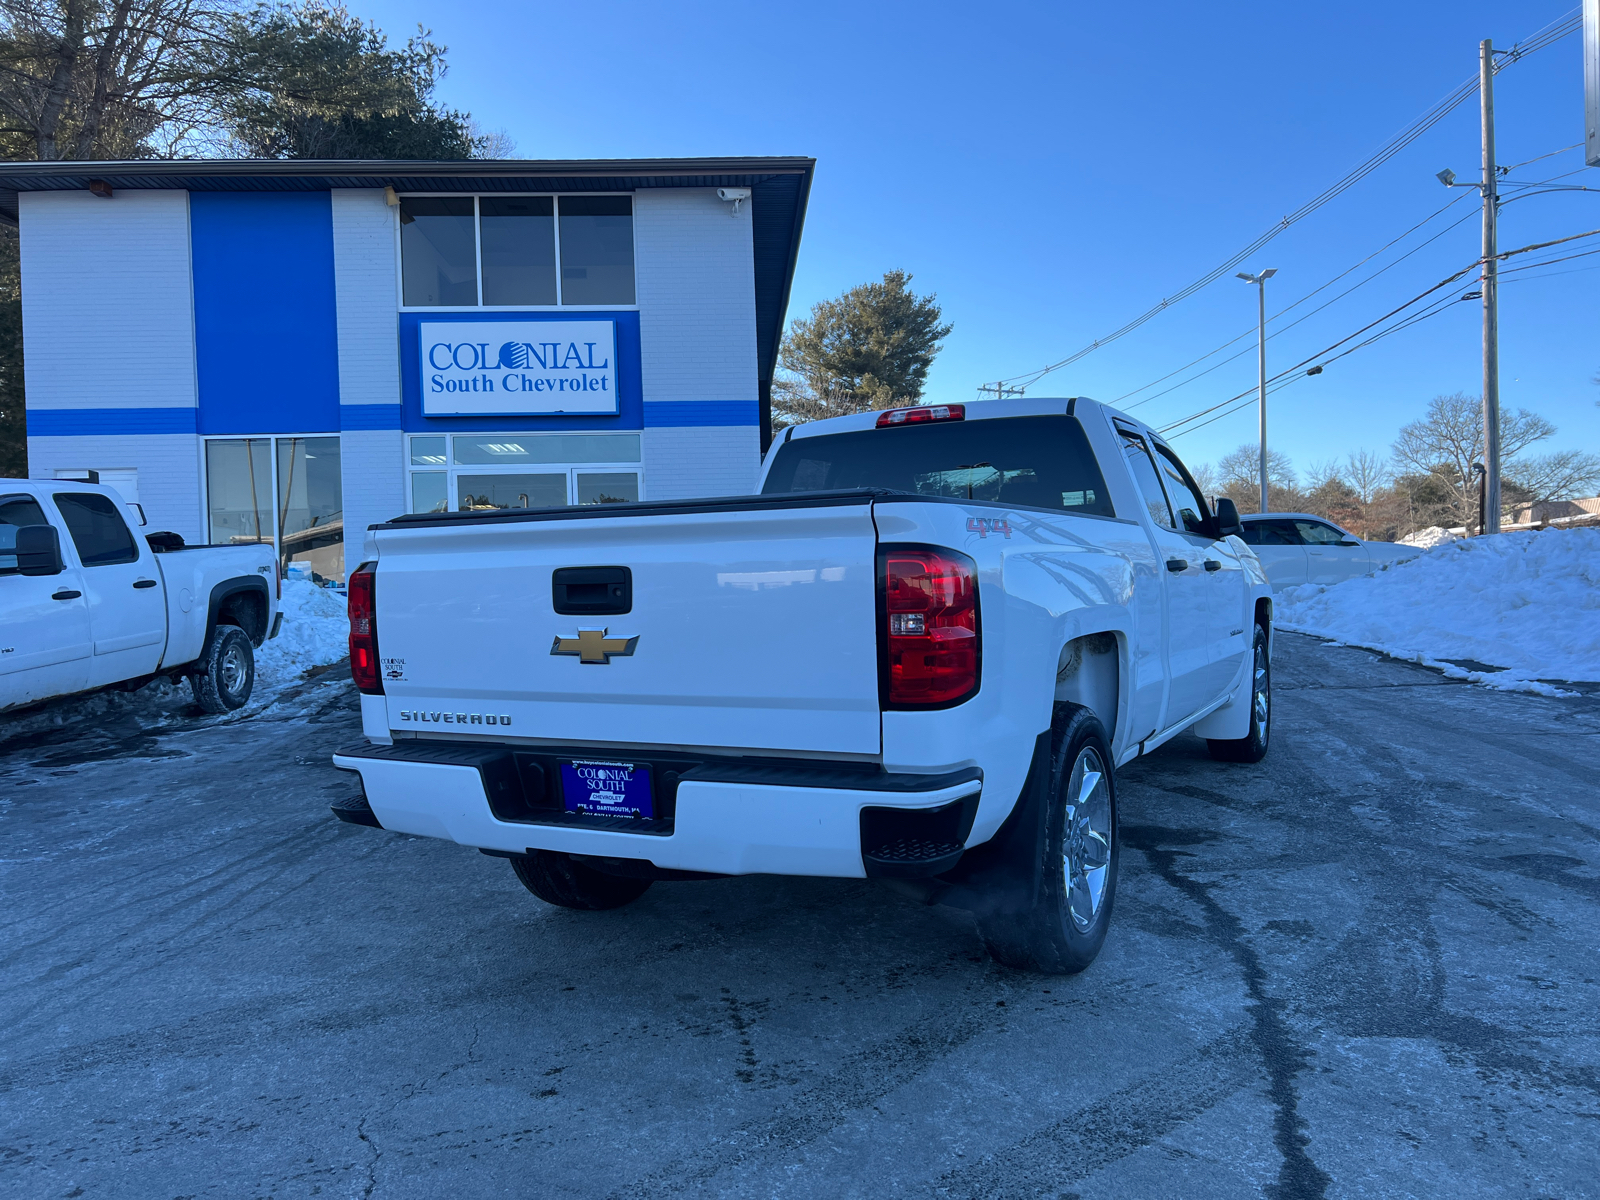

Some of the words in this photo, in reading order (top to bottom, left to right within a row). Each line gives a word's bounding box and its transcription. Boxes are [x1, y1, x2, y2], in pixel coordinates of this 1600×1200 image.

[428, 341, 608, 371] COLONIAL
[431, 374, 494, 393] South
[502, 373, 608, 393] Chevrolet
[400, 710, 512, 726] SILVERADO
[577, 767, 633, 781] COLONIAL
[586, 779, 625, 791] SOUTH
[592, 793, 622, 801] CHEVROLET
